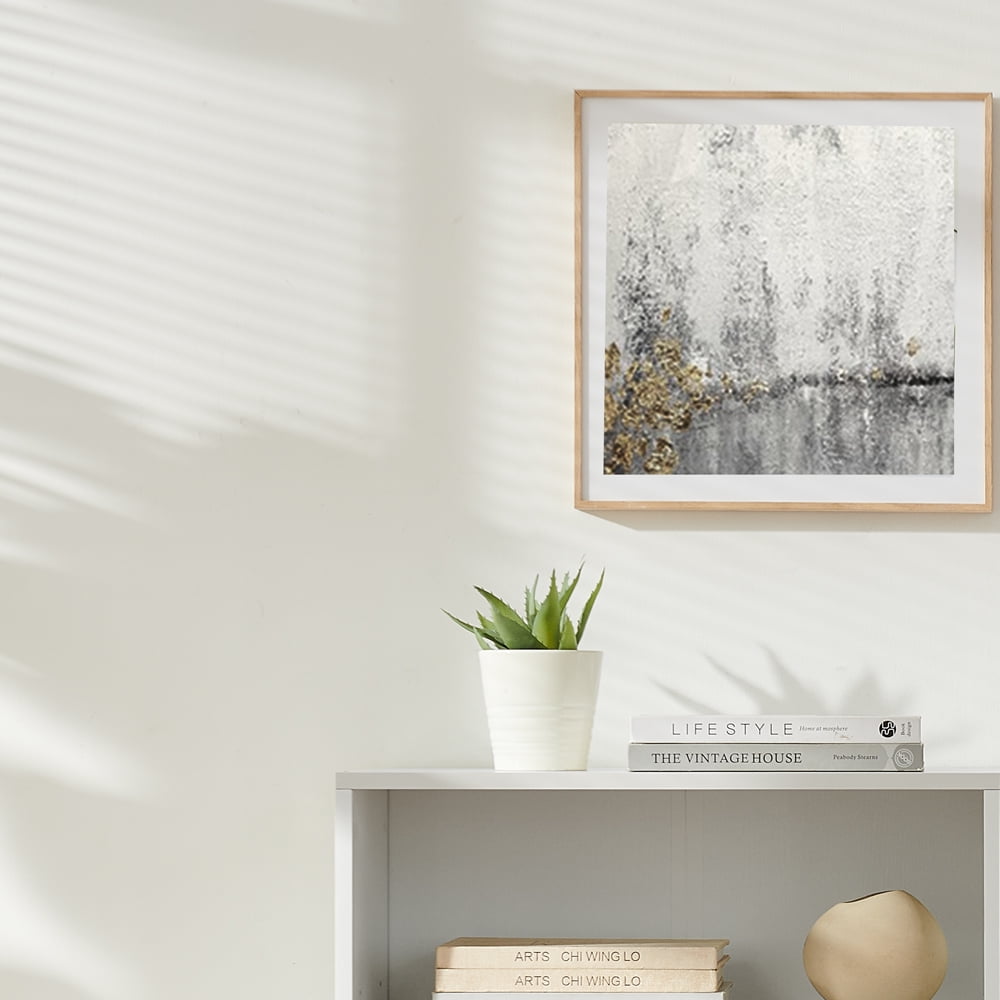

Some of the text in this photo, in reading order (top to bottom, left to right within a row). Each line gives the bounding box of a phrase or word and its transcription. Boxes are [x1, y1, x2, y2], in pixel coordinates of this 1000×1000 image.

[672, 723, 793, 736] LIFE STYLE
[651, 753, 802, 764] THE VINTAGE HOUSE
[514, 952, 640, 962] ARTS CHI WING LO
[514, 976, 640, 986] ARTS CHI WING LO
